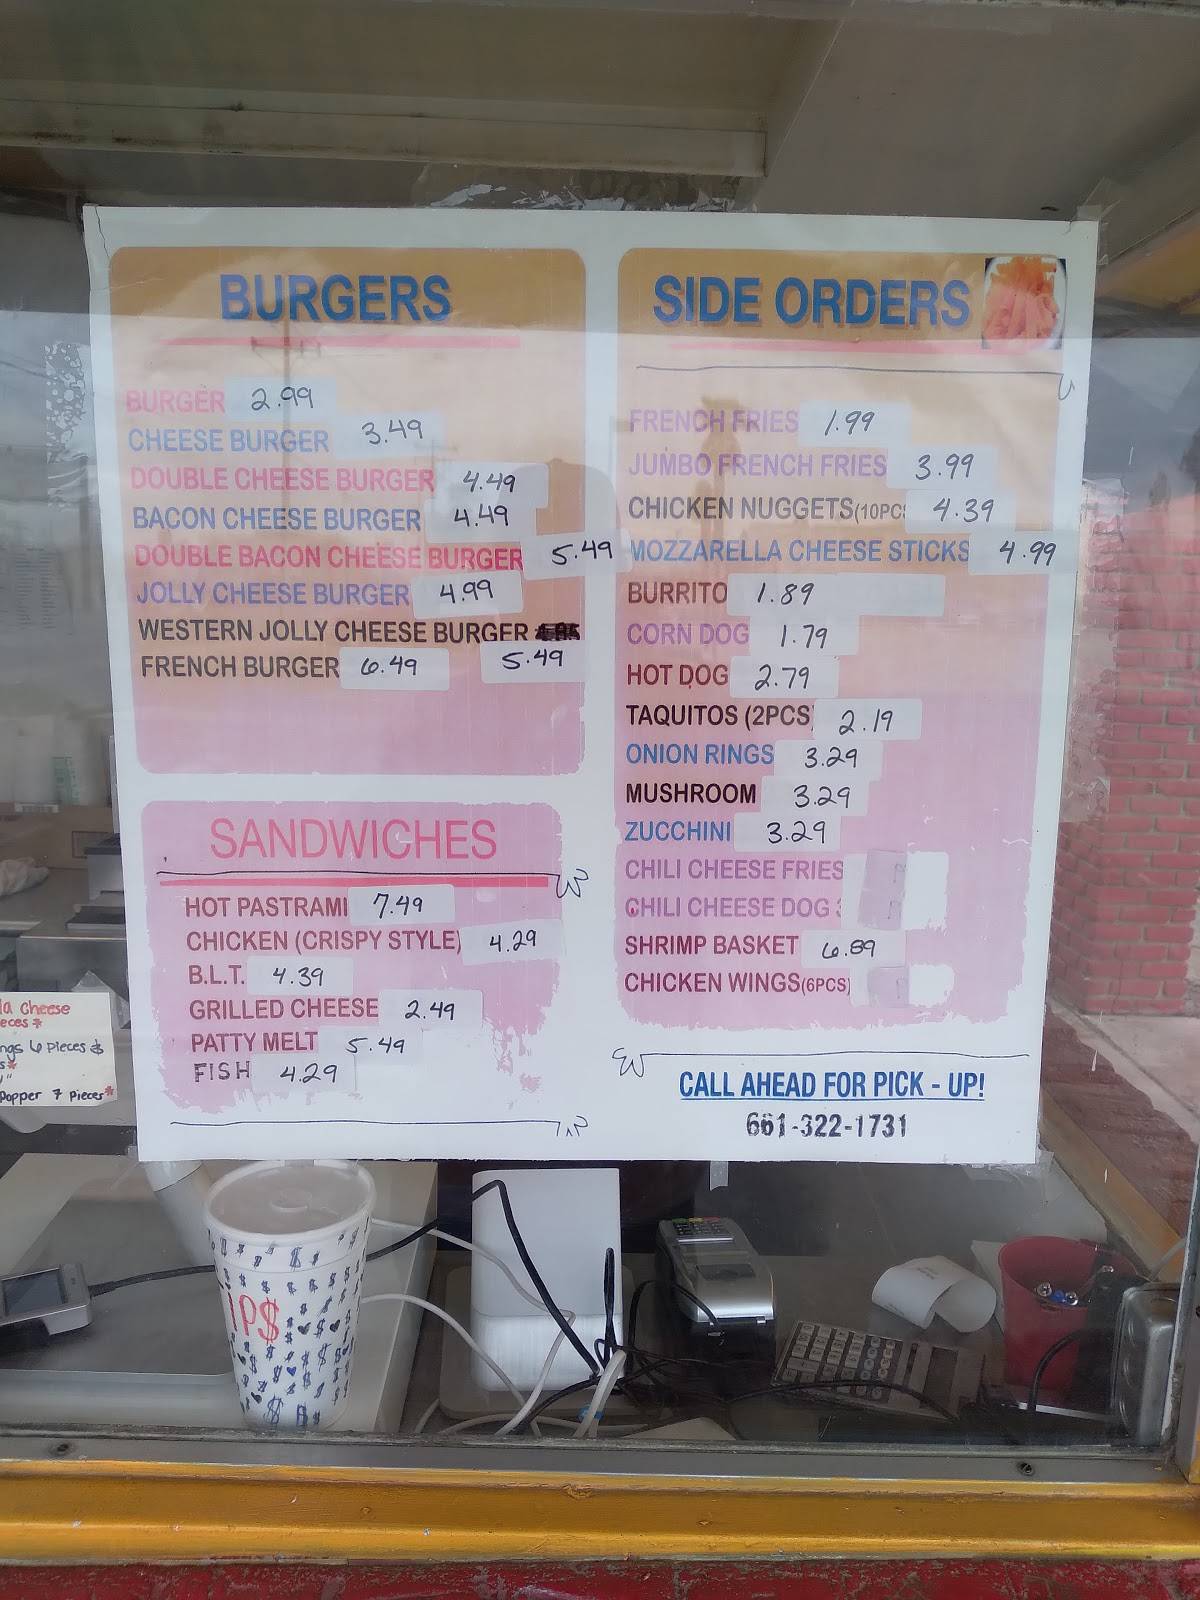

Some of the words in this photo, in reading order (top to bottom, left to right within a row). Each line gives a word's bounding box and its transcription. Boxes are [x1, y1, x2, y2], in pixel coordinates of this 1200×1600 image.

[219, 274, 452, 322] BURGERS
[653, 274, 761, 324] SIDE
[774, 277, 971, 328] ORDERS
[126, 389, 225, 414] BURGER
[251, 387, 313, 411] 2.99
[362, 419, 423, 445] 3.49
[630, 409, 725, 432] FRENCH
[732, 409, 800, 433] FRIES
[825, 410, 875, 436] 1.99
[128, 428, 223, 452] CHEESE
[230, 428, 329, 453] BURGER
[629, 453, 712, 476] JUMBO
[718, 453, 814, 477] FRENCH
[821, 454, 887, 477] FRIES
[915, 453, 974, 481] 3.99
[131, 466, 227, 490] DOUBLE
[235, 467, 329, 491] CHEESE
[337, 469, 434, 493] BURGER
[463, 470, 515, 493] 4.49
[133, 506, 215, 530] BACON
[223, 507, 317, 531] CHEESE
[325, 508, 421, 532] BURGER
[454, 504, 509, 528] 4.49
[628, 496, 734, 520] CHICKEN
[933, 498, 994, 522] 4.39
[136, 544, 232, 568] DOUBLE
[239, 545, 320, 568] BACON
[328, 546, 421, 569] CHEESE
[428, 547, 523, 571] BURGER
[552, 540, 613, 566] 5.49
[630, 539, 782, 562] MOZZARELLA
[789, 539, 882, 562] CHEESE
[889, 539, 969, 562] STICKS
[1000, 540, 1057, 565] 4.99
[136, 582, 206, 605] JOLLY
[213, 582, 307, 605] CHEESE
[314, 582, 410, 606] BURGER
[440, 579, 493, 604] 4.99
[628, 581, 728, 604] BURRITO
[757, 582, 815, 606] 1.89
[139, 619, 252, 642] WESTERN
[259, 620, 327, 642] JOLLY
[334, 620, 427, 643] CHEESE
[434, 621, 528, 643] BURGER
[627, 623, 692, 645] CORN
[700, 623, 750, 645] DOG
[781, 624, 828, 650] 1.79
[141, 656, 236, 679] FRENCH
[244, 655, 339, 679] BURGER
[361, 656, 418, 677] 6.49
[502, 649, 563, 670] 5.49
[627, 663, 673, 686] HOT
[680, 663, 729, 686] DOG
[755, 664, 810, 691] 2.79
[626, 704, 738, 727] TAQUITOS
[839, 708, 893, 735] 2.19
[625, 743, 698, 765] ONION
[705, 743, 774, 765] RINGS
[805, 746, 857, 768] 3.29
[625, 783, 757, 804] MUSHROOM
[794, 785, 850, 808] 3.29
[210, 818, 498, 860] SANDWICHES
[625, 821, 731, 842] ZUCCHINI
[767, 820, 826, 844] 3.29
[625, 860, 681, 880] CHILI
[688, 860, 775, 880] CHEESE
[782, 860, 843, 880] FRIES
[185, 897, 231, 917] HOT
[238, 897, 348, 918] PASTRAMI
[373, 893, 423, 920] 7.49
[625, 897, 681, 918] CHILI
[688, 897, 775, 918] CHEESE
[781, 897, 830, 918] DOG
[186, 931, 288, 951] CHICKEN
[295, 930, 381, 956] (CRISPY
[388, 930, 462, 955] STYLE)
[490, 929, 537, 953] 4.29
[625, 935, 706, 956] SHRIMP
[713, 935, 799, 956] BASKET
[821, 939, 876, 960] 6.89
[189, 965, 245, 985] B.L.T.
[273, 966, 324, 988] 4.39
[625, 972, 722, 993] CHICKEN
[189, 999, 284, 1020] GRILLED
[290, 998, 379, 1019] CHEESE
[405, 999, 455, 1022] 2.49
[191, 1033, 256, 1053] PATTY
[263, 1031, 318, 1052] MELT
[347, 1037, 405, 1056] 5.49
[194, 1061, 251, 1082] FISH
[280, 1063, 337, 1085] 4.29
[53, 1089, 62, 1100] 7
[679, 1071, 734, 1097] CALL
[740, 1071, 816, 1097] AHEAD
[824, 1071, 866, 1097] FOR
[873, 1071, 924, 1097] PICK
[948, 1072, 985, 1097] UP!
[746, 1112, 907, 1138] 661-322-1731
